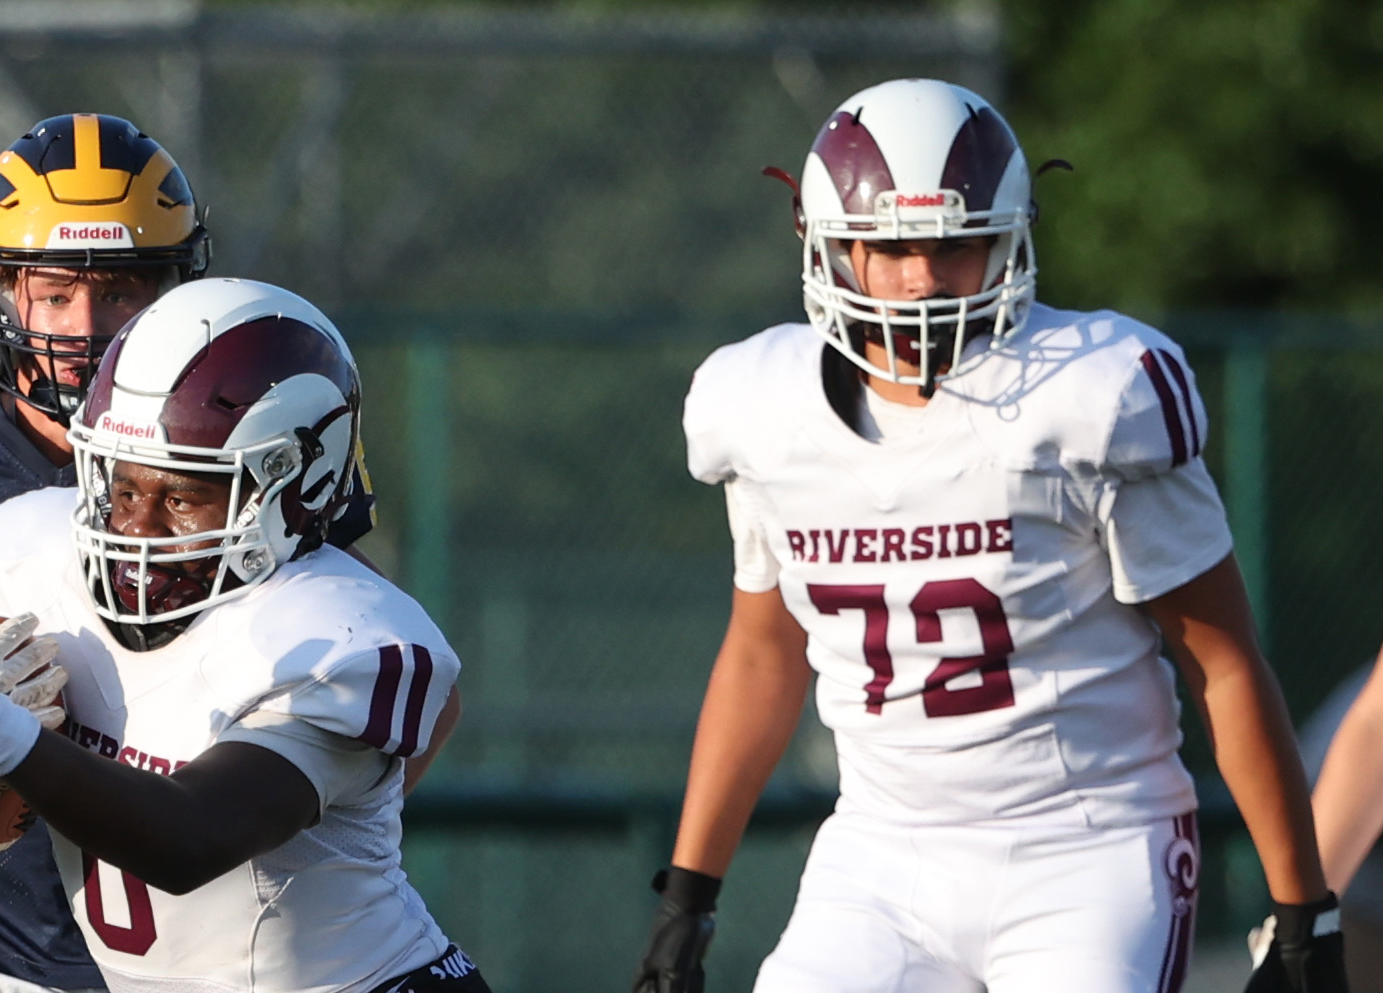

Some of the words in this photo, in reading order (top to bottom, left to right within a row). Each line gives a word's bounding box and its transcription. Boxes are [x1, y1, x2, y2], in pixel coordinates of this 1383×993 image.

[59, 226, 123, 240] Riddell
[101, 416, 157, 440] Riddell
[785, 518, 1014, 564] RIVERSIDE
[805, 576, 1016, 719] 72
